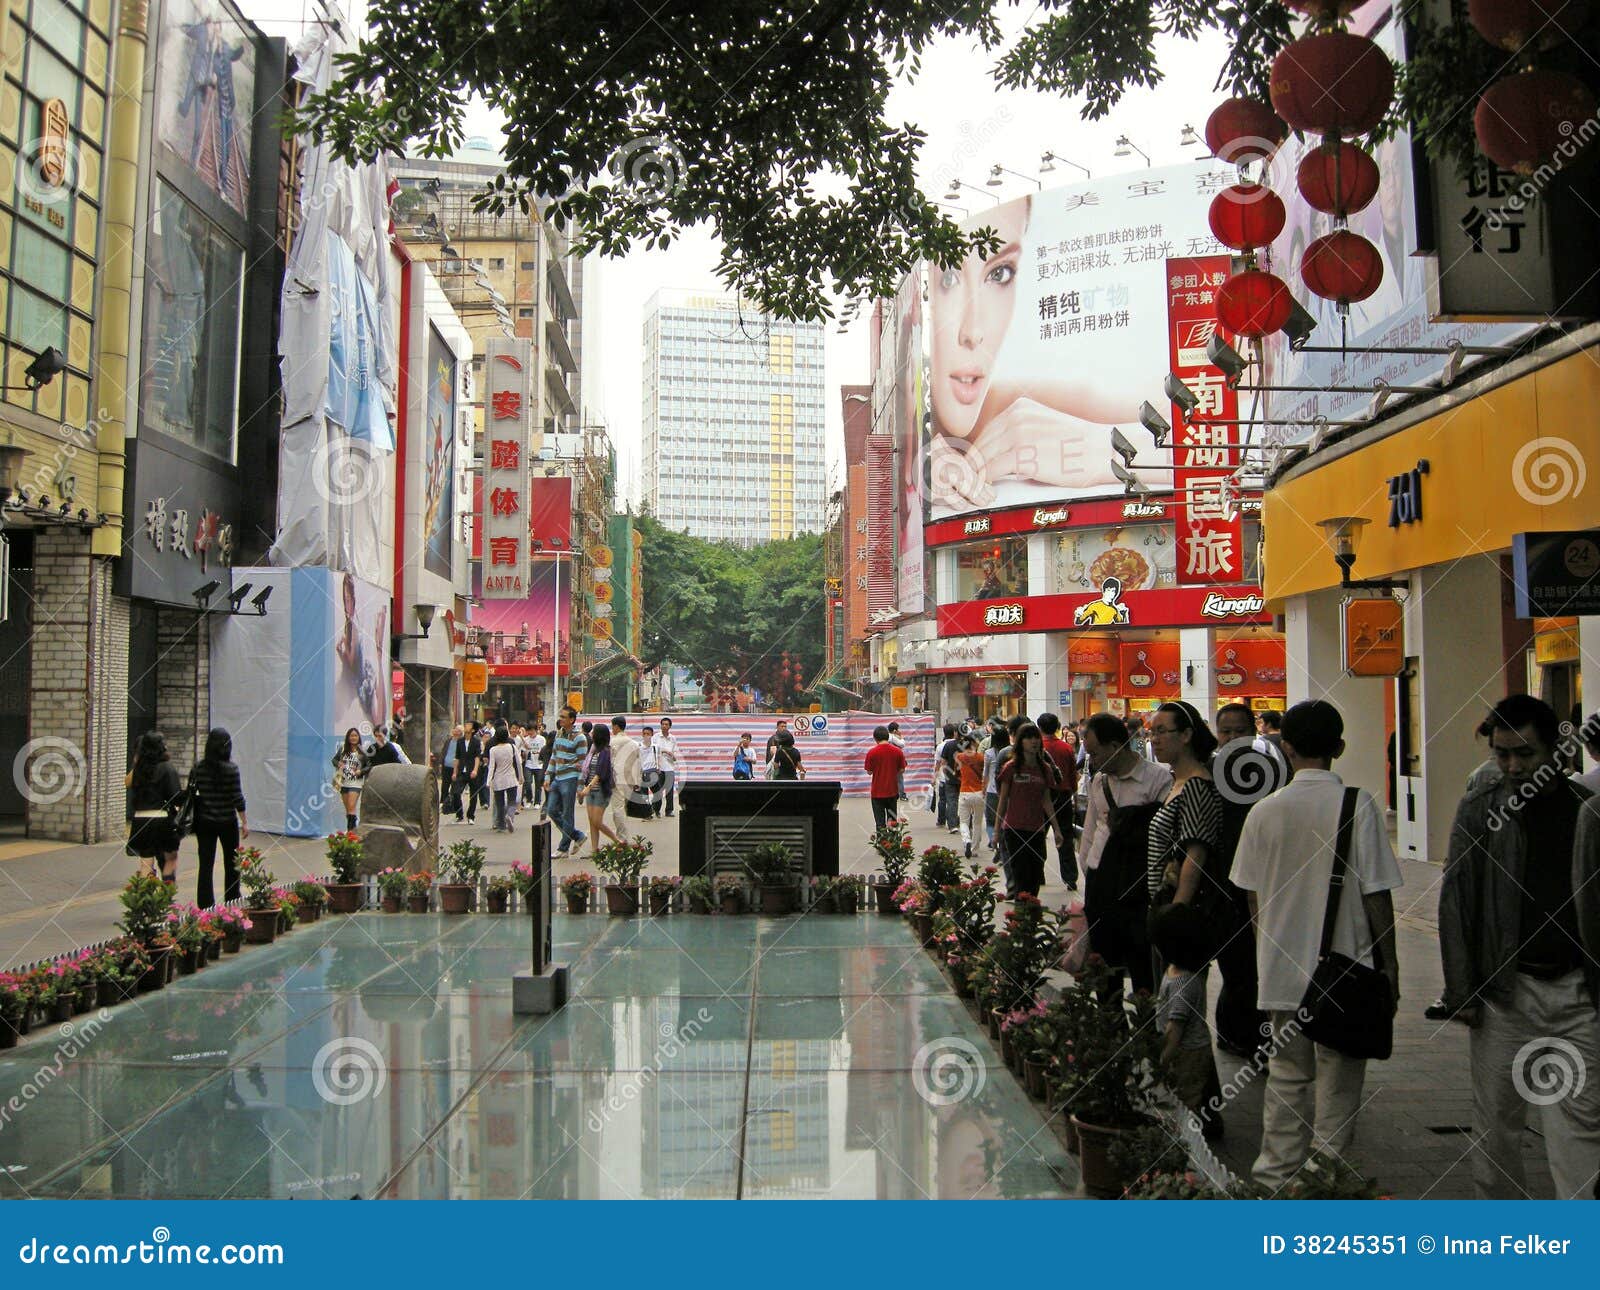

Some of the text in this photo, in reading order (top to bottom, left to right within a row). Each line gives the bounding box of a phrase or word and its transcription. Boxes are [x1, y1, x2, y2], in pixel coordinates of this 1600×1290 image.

[1036, 223, 1163, 260] 第一款改善肌肤的粉饼
[1169, 271, 1226, 290] 参团人数
[1171, 290, 1217, 307] 广东第
[1039, 309, 1131, 341] 清润两用粉饼
[489, 390, 521, 567] 安踏体育
[1180, 371, 1234, 576] 南湖国旅
[1032, 508, 1068, 526] Kungfu
[1122, 502, 1165, 518] 真功夫
[964, 518, 990, 535] 真功夫
[485, 575, 522, 591] ANTA
[1203, 595, 1263, 616] Kungfu
[985, 606, 1022, 626] 真功夫
